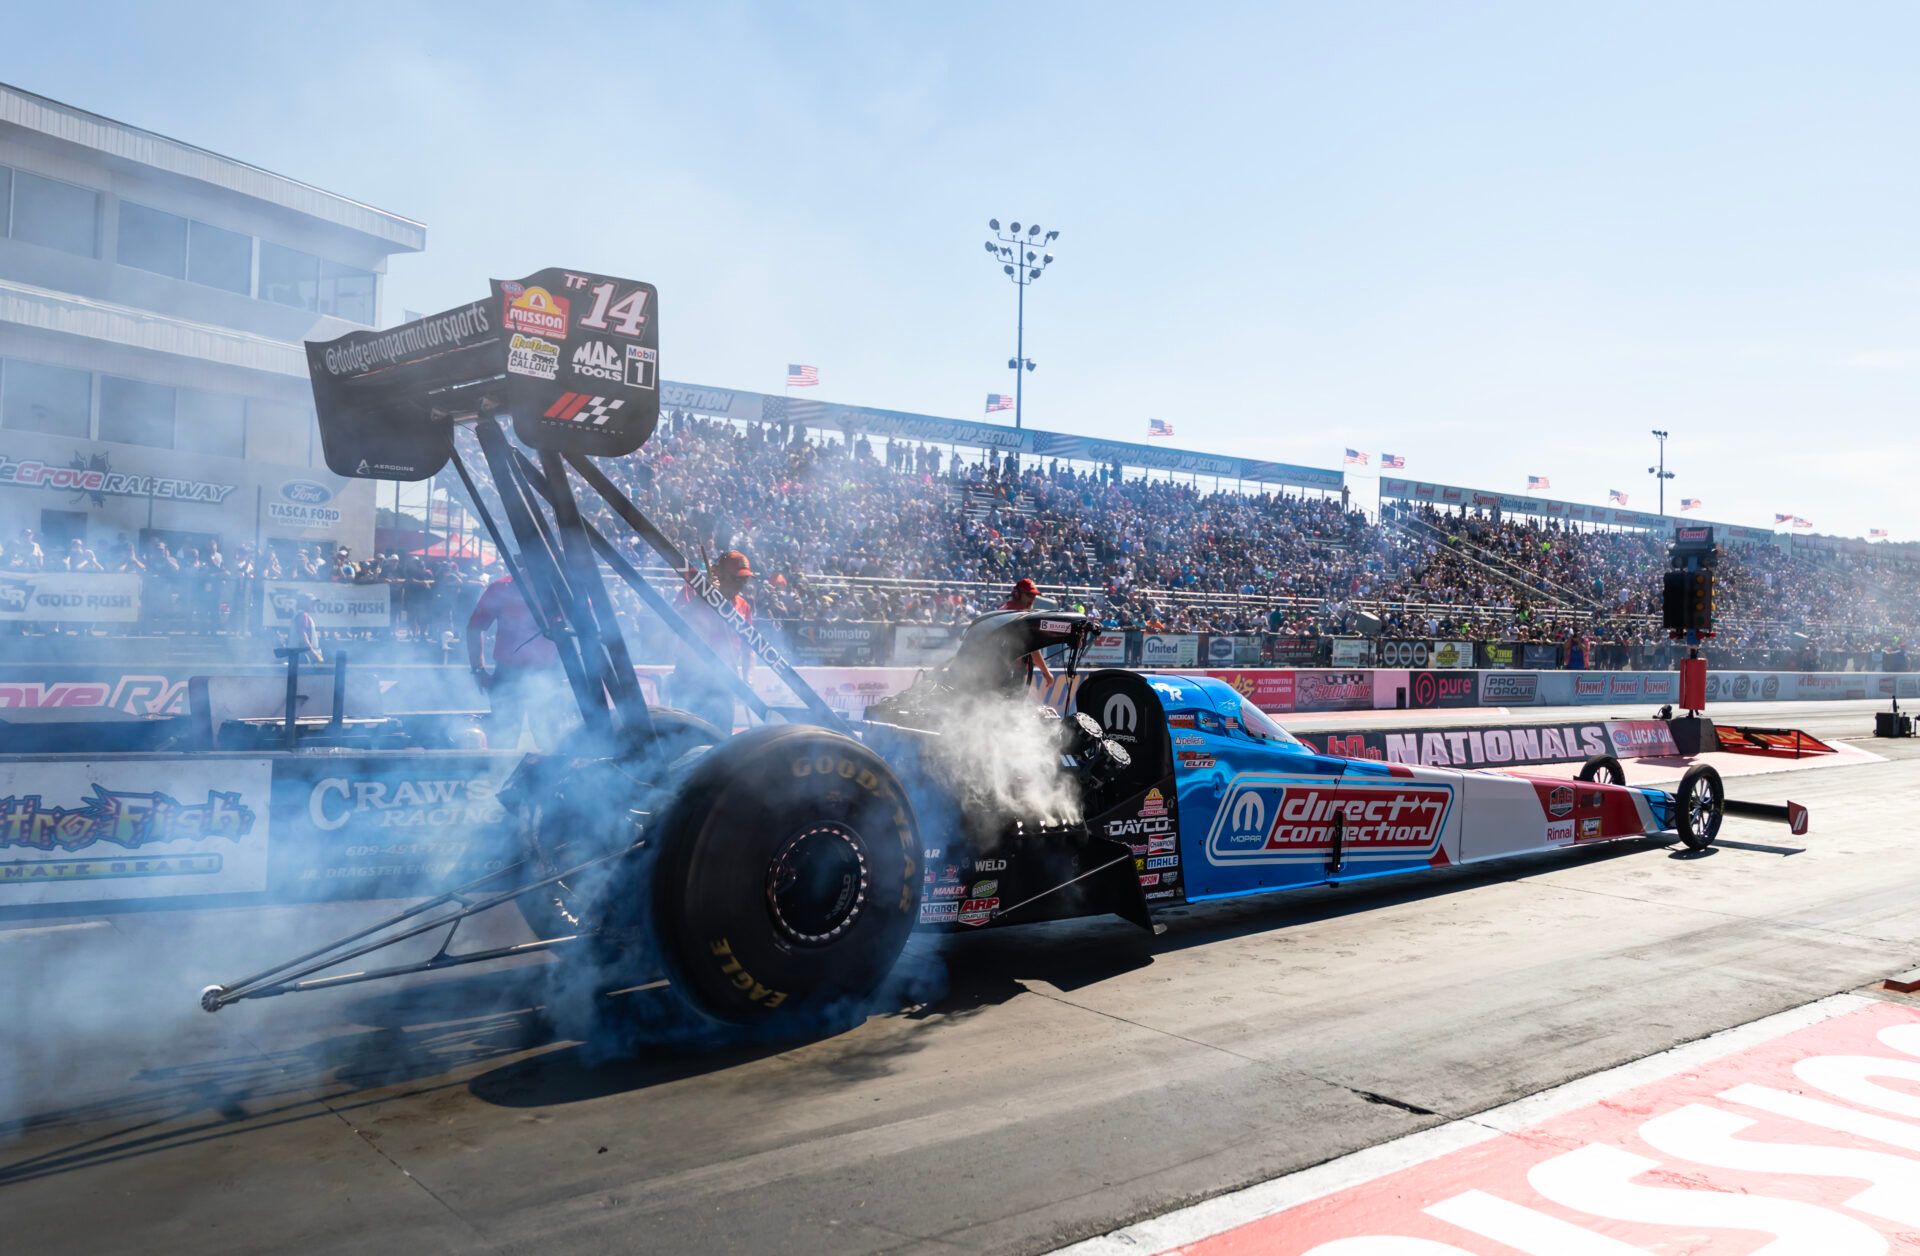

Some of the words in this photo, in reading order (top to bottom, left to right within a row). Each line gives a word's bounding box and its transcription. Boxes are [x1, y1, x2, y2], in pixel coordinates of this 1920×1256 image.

[564, 273, 589, 290] TF
[580, 282, 649, 337] 14
[325, 302, 490, 375] @dodgemoparmotorsports
[511, 350, 529, 361] ALL
[531, 353, 555, 365] STAR
[573, 341, 623, 371] MAC
[628, 347, 655, 361] Mobil
[510, 358, 554, 373] CALLOUT
[572, 364, 622, 381] TOOLS
[635, 361, 643, 384] 1
[661, 386, 733, 412] SECTION
[953, 425, 976, 441] VIP
[976, 428, 1025, 449] SECTION
[1197, 456, 1233, 474] SECTION
[104, 474, 236, 502] RACEWAY
[290, 484, 323, 501] Ford
[271, 504, 307, 518] TASCA
[310, 508, 340, 521] FORD
[36, 593, 82, 607] GOLD
[86, 594, 131, 610] RUSH
[349, 602, 385, 616] RUSH
[690, 573, 790, 675] INSURANCE
[818, 627, 871, 641] holmatro
[1147, 642, 1178, 654] United
[1438, 678, 1472, 699] pure
[1489, 677, 1515, 687] PRO
[1486, 687, 1536, 695] TORQUE
[1102, 733, 1137, 742] MOPAR
[1631, 729, 1657, 744] LUCAS
[1658, 728, 1674, 743] OIL
[1386, 725, 1607, 767] NATIONALS
[309, 777, 495, 830] CRAW'S
[1282, 791, 1411, 822] direct
[380, 808, 506, 827] RACING
[1109, 817, 1170, 836] DAYCO
[1150, 840, 1175, 849] CHAMPION
[1230, 834, 1262, 843] MOPAR
[326, 862, 400, 879] DRAGSTER
[974, 859, 1007, 873] WELD
[1148, 856, 1178, 869] MAHLE
[932, 885, 967, 896] MANLEY
[921, 903, 958, 915] Strange
[961, 898, 1000, 912] ARP
[710, 936, 789, 1009] EAGLE
